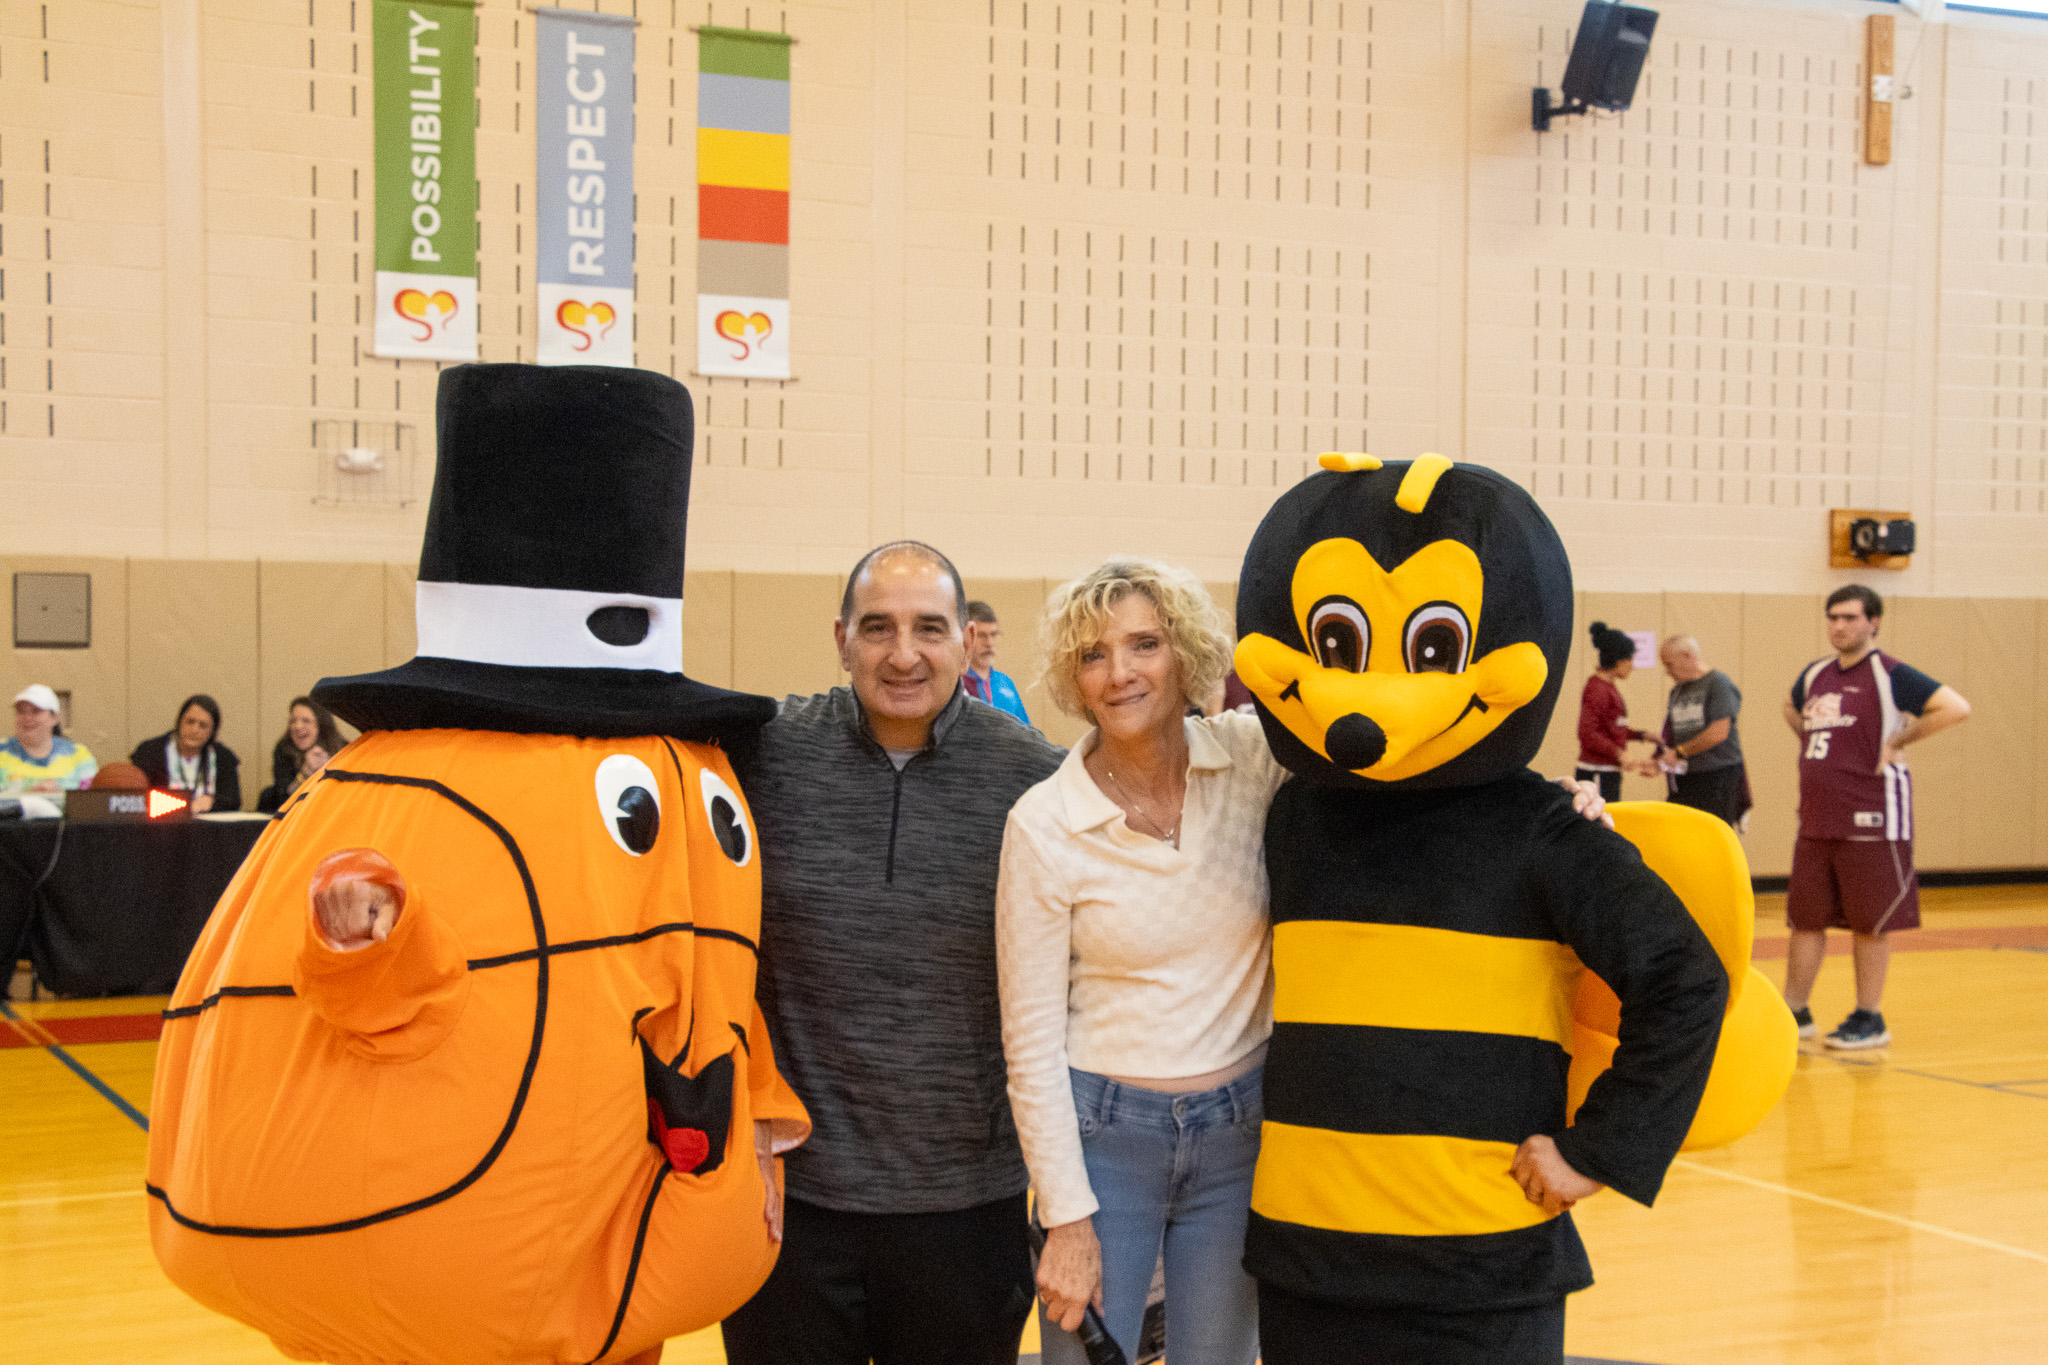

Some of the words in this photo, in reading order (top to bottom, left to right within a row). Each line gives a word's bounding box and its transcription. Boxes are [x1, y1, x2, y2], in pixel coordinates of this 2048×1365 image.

[409, 9, 442, 262] POSSIBILITY
[566, 31, 606, 276] RESPECT
[1805, 731, 1832, 759] 15
